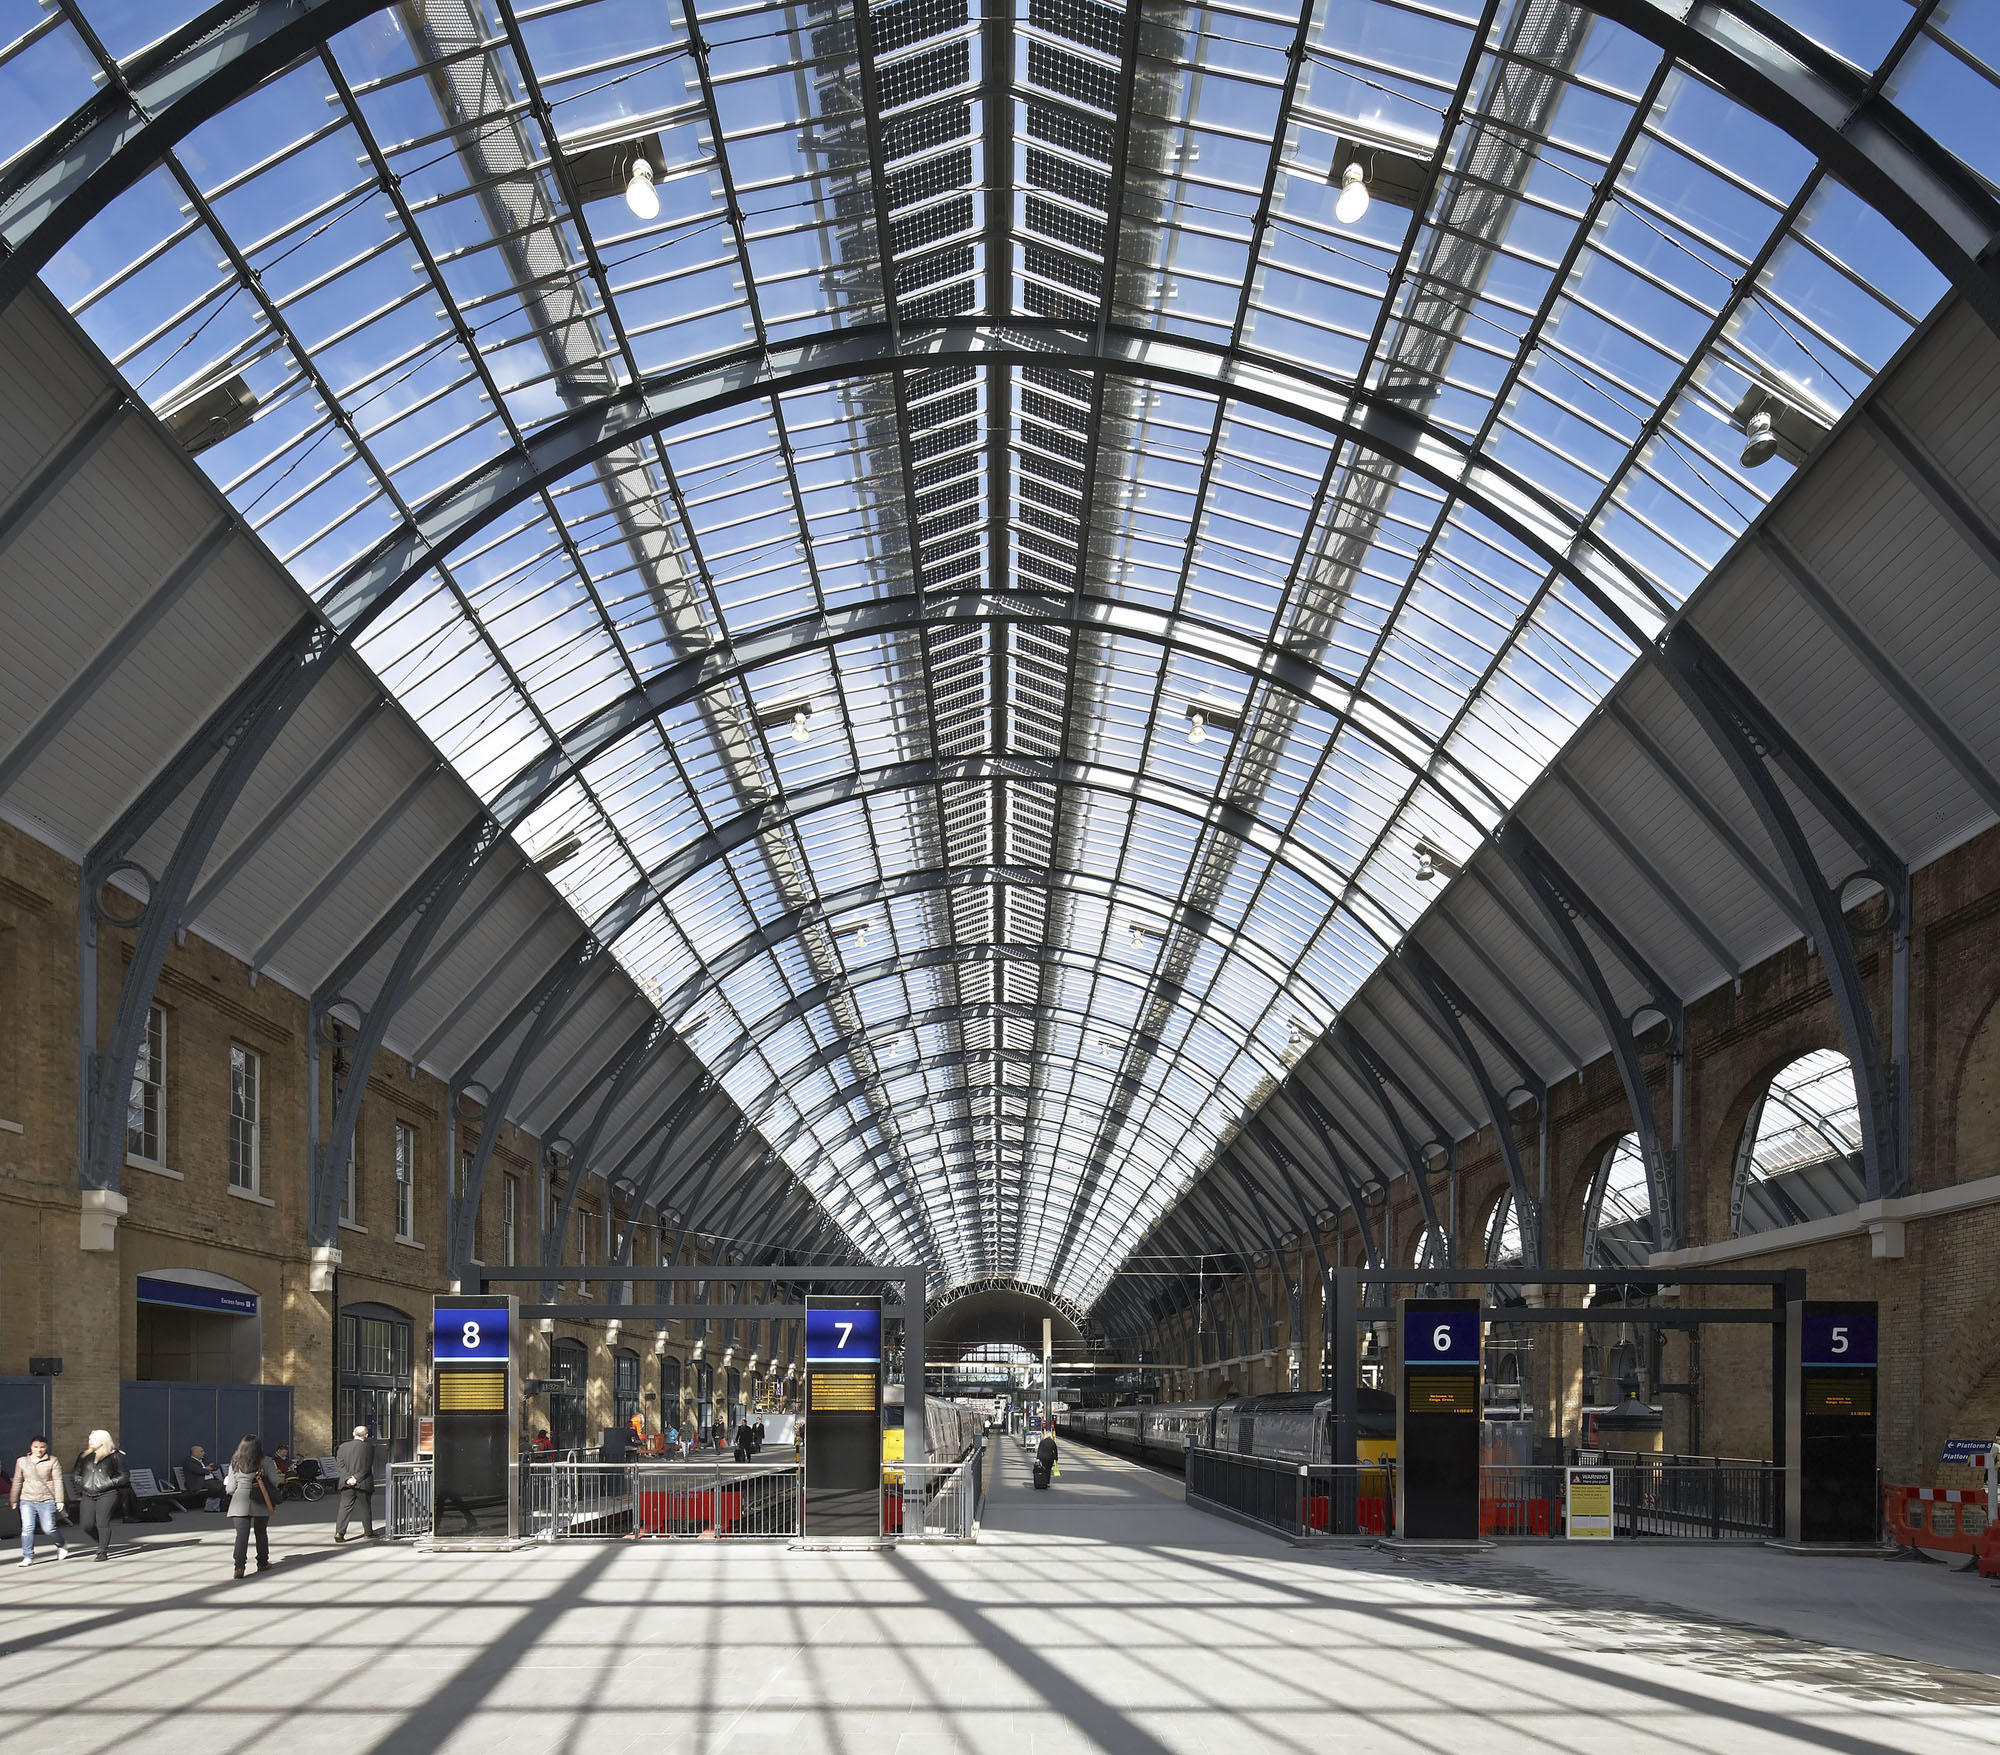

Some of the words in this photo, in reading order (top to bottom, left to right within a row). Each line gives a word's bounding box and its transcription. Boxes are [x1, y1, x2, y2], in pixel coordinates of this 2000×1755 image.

[221, 1297, 234, 1305] Excess
[462, 1321, 481, 1349] 8
[834, 1322, 853, 1349] 7
[1433, 1324, 1452, 1352] 6
[1831, 1327, 1849, 1353] 5
